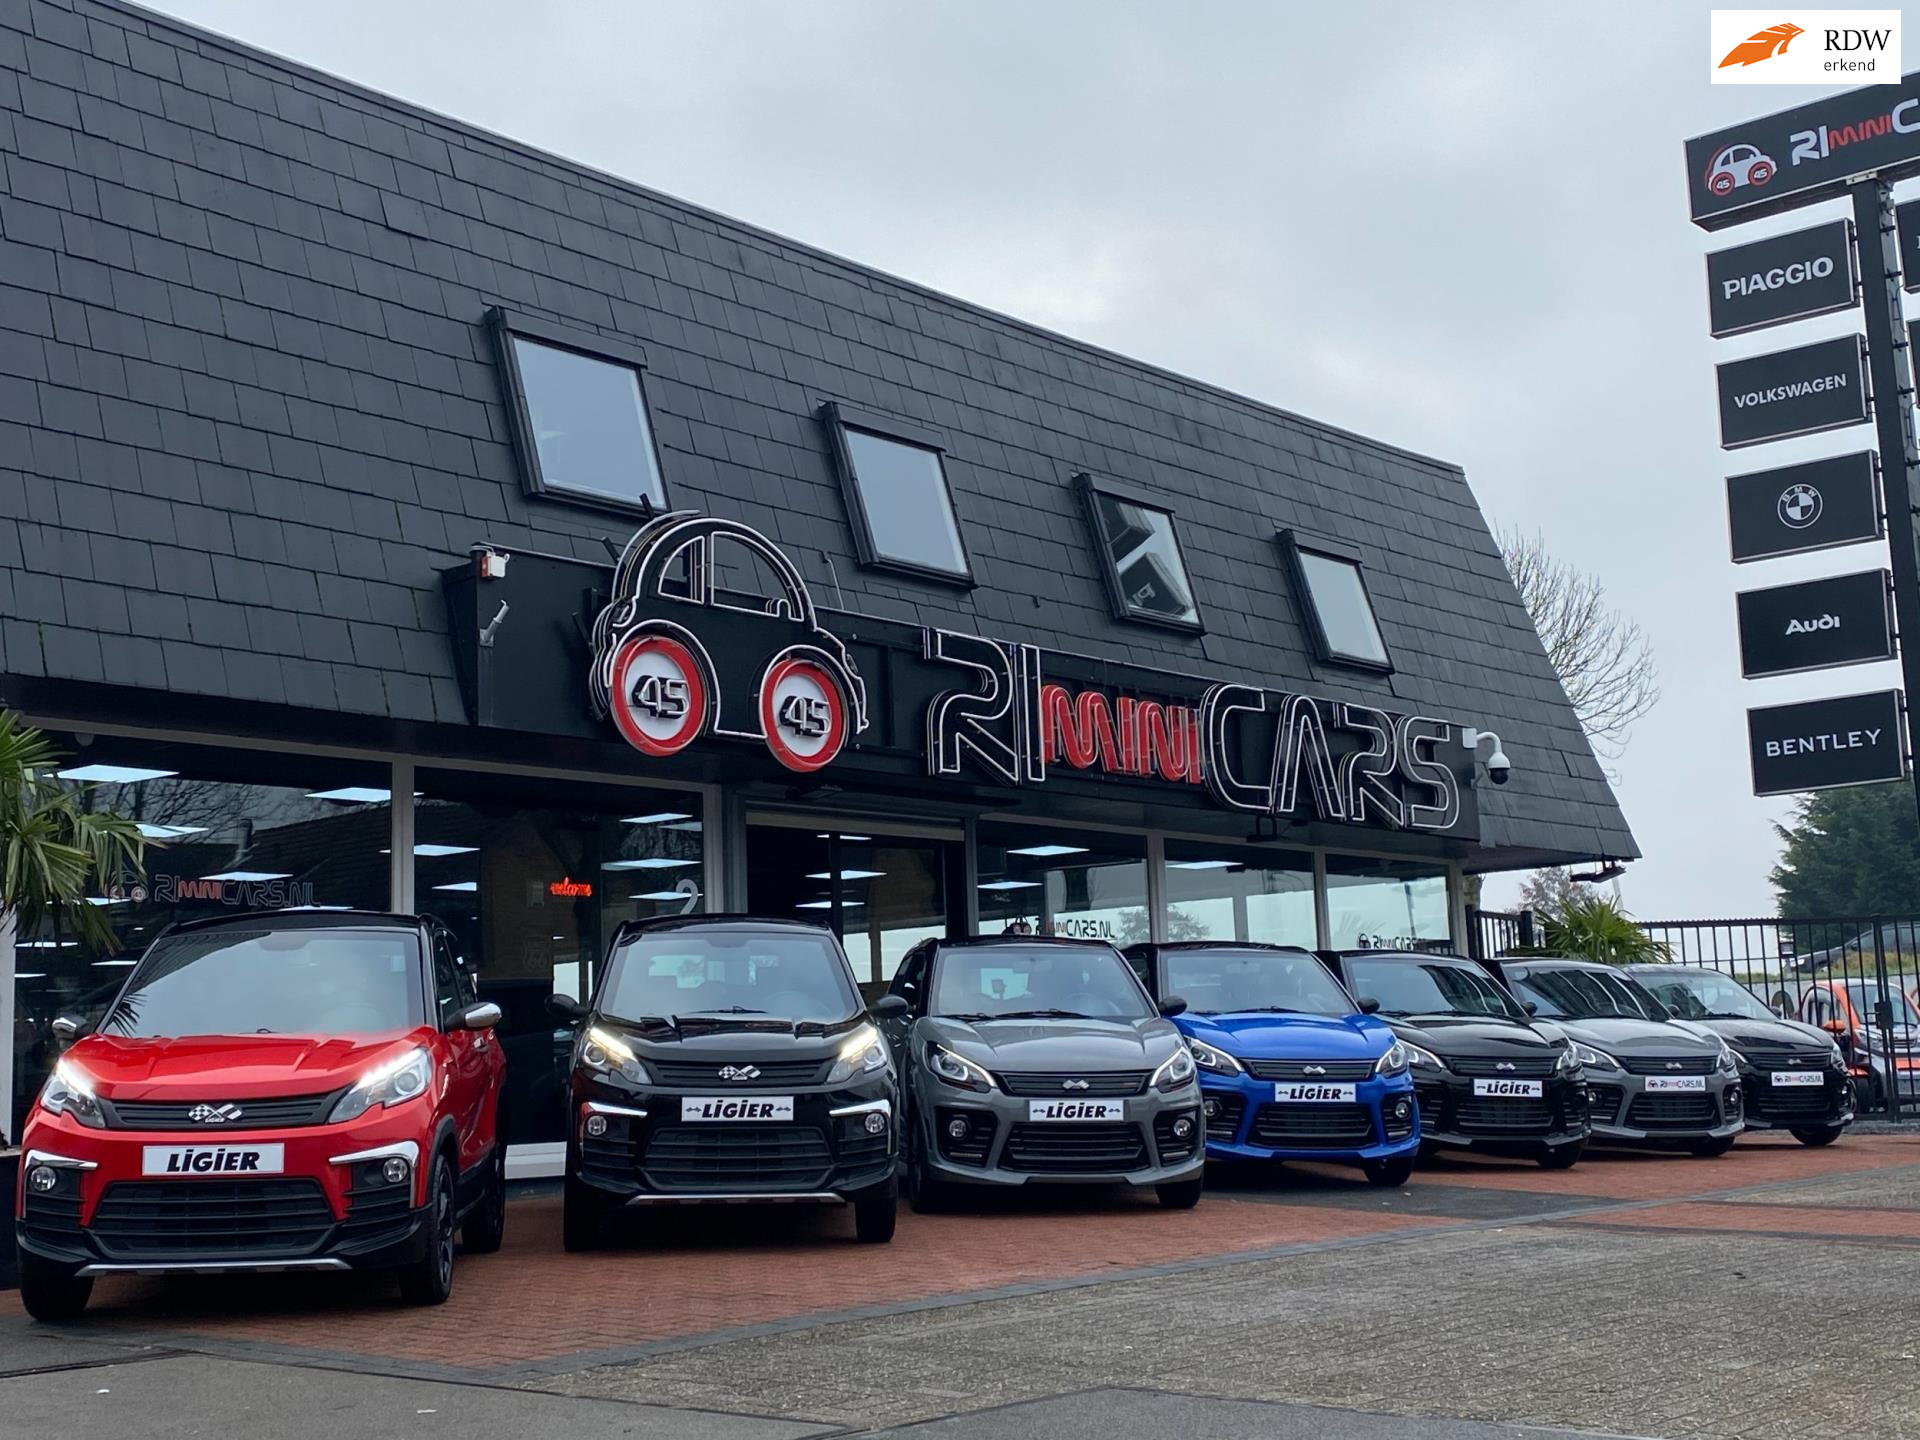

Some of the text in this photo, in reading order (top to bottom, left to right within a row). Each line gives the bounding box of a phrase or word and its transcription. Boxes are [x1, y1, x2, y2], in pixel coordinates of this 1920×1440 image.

[1722, 257, 1834, 300] PIAGGIO
[1734, 373, 1847, 408] VOLKSWAGEN
[1785, 614, 1841, 636] Audi
[631, 674, 691, 720] 45
[779, 694, 831, 738] 45
[1766, 728, 1882, 757] BENTLEY
